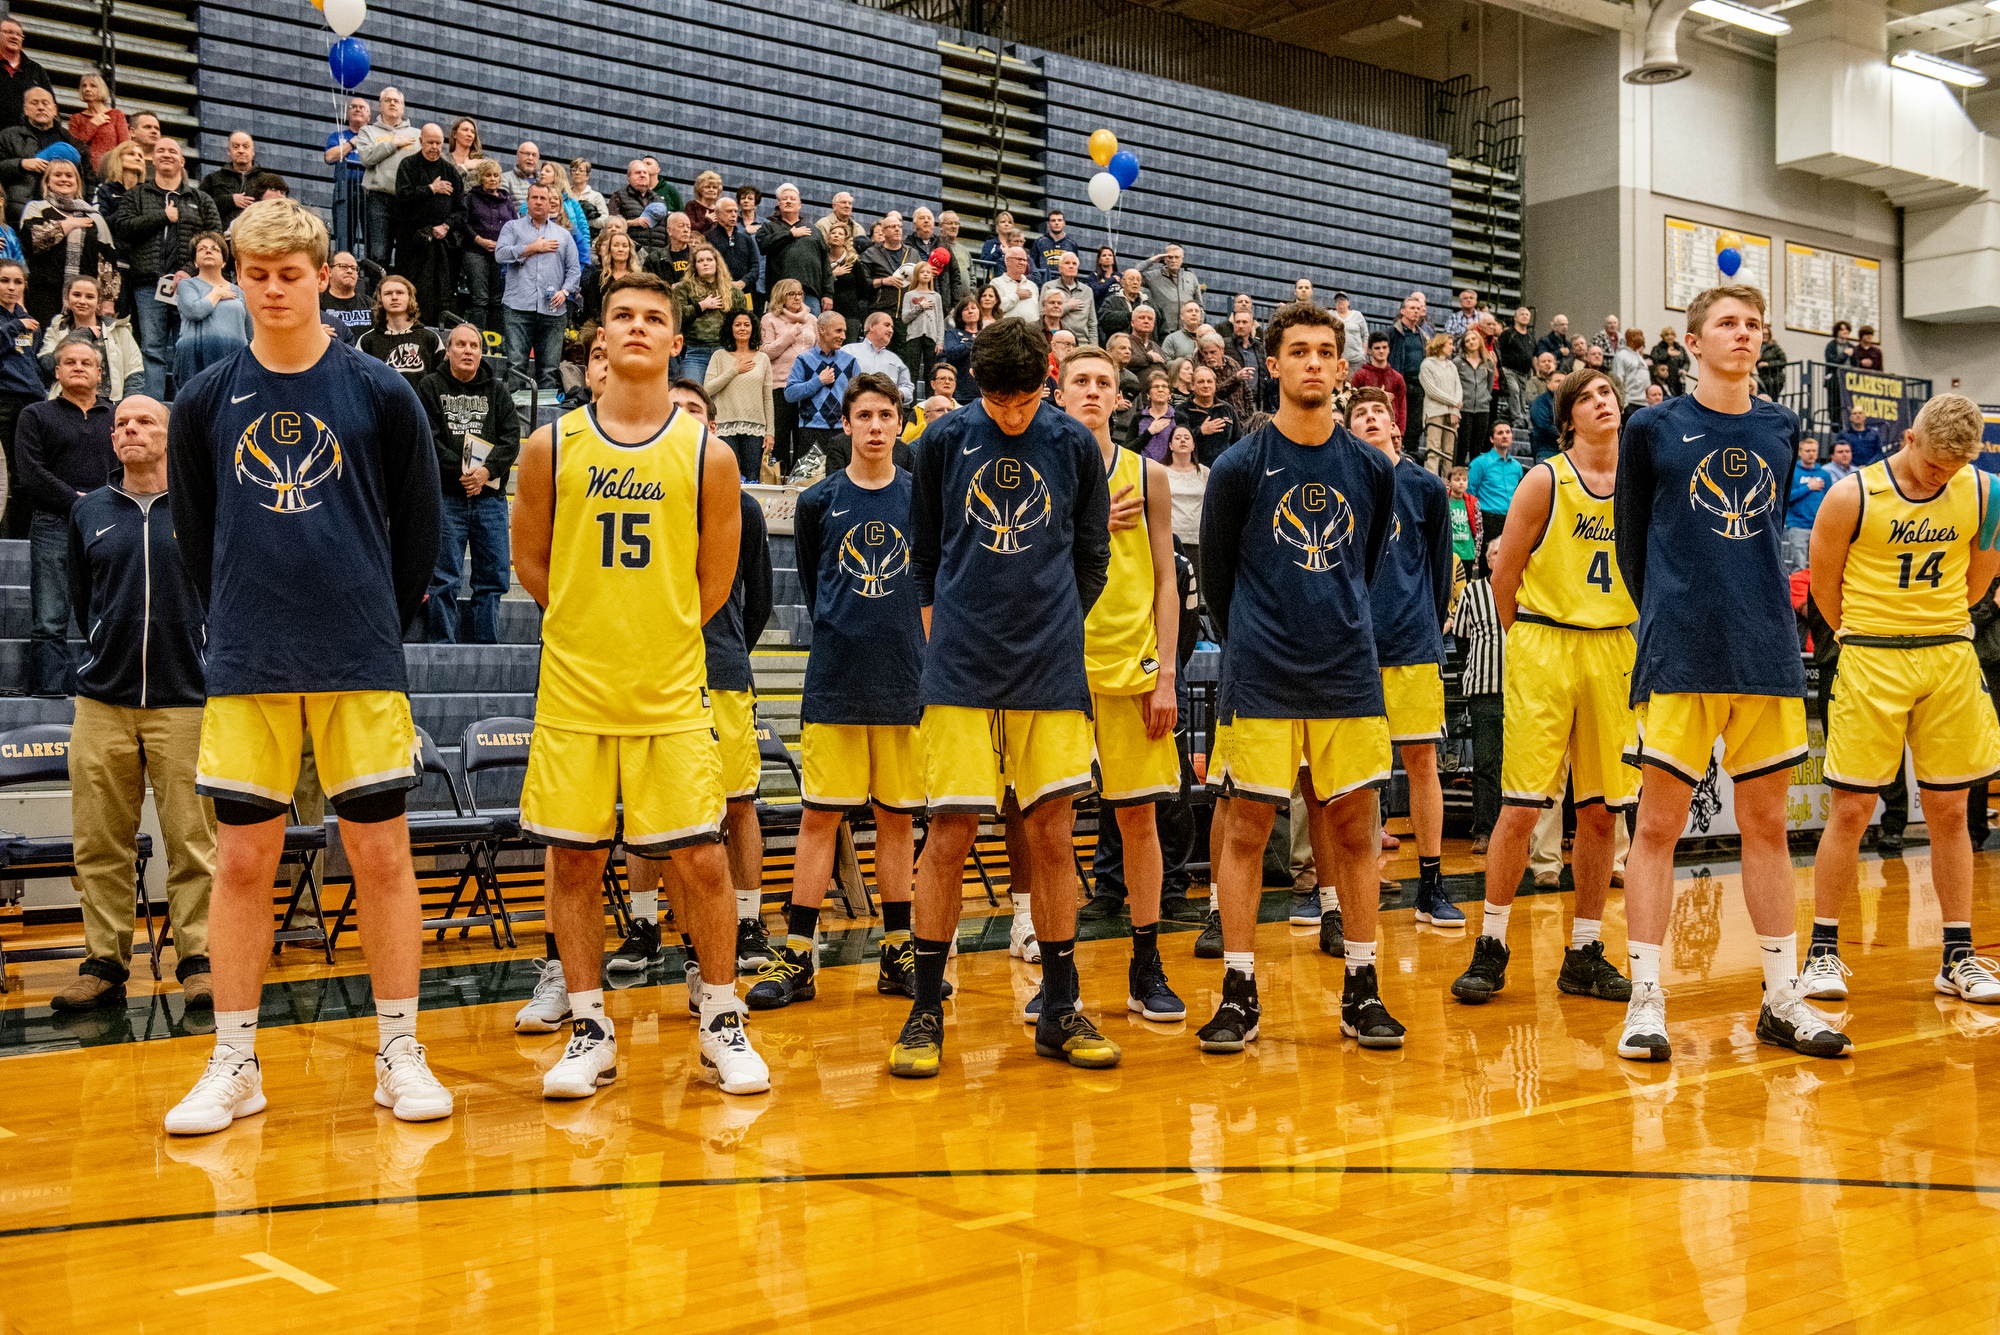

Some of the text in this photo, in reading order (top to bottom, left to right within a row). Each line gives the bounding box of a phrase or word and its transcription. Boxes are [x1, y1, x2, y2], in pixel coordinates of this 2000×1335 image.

[385, 349, 424, 372] Aces
[1845, 372, 1902, 398] CLARKSTON
[1852, 394, 1898, 421] WOLVES
[271, 411, 301, 444] C
[995, 457, 1021, 489] C
[1722, 447, 1748, 477] C
[585, 465, 666, 501] Wolves
[1302, 483, 1326, 512] C
[595, 511, 651, 570] 15
[864, 520, 885, 546] C
[1887, 517, 1960, 545] Wolves
[1586, 550, 1613, 594] 4
[1897, 551, 1946, 590] 14
[476, 732, 533, 746] CLARKST
